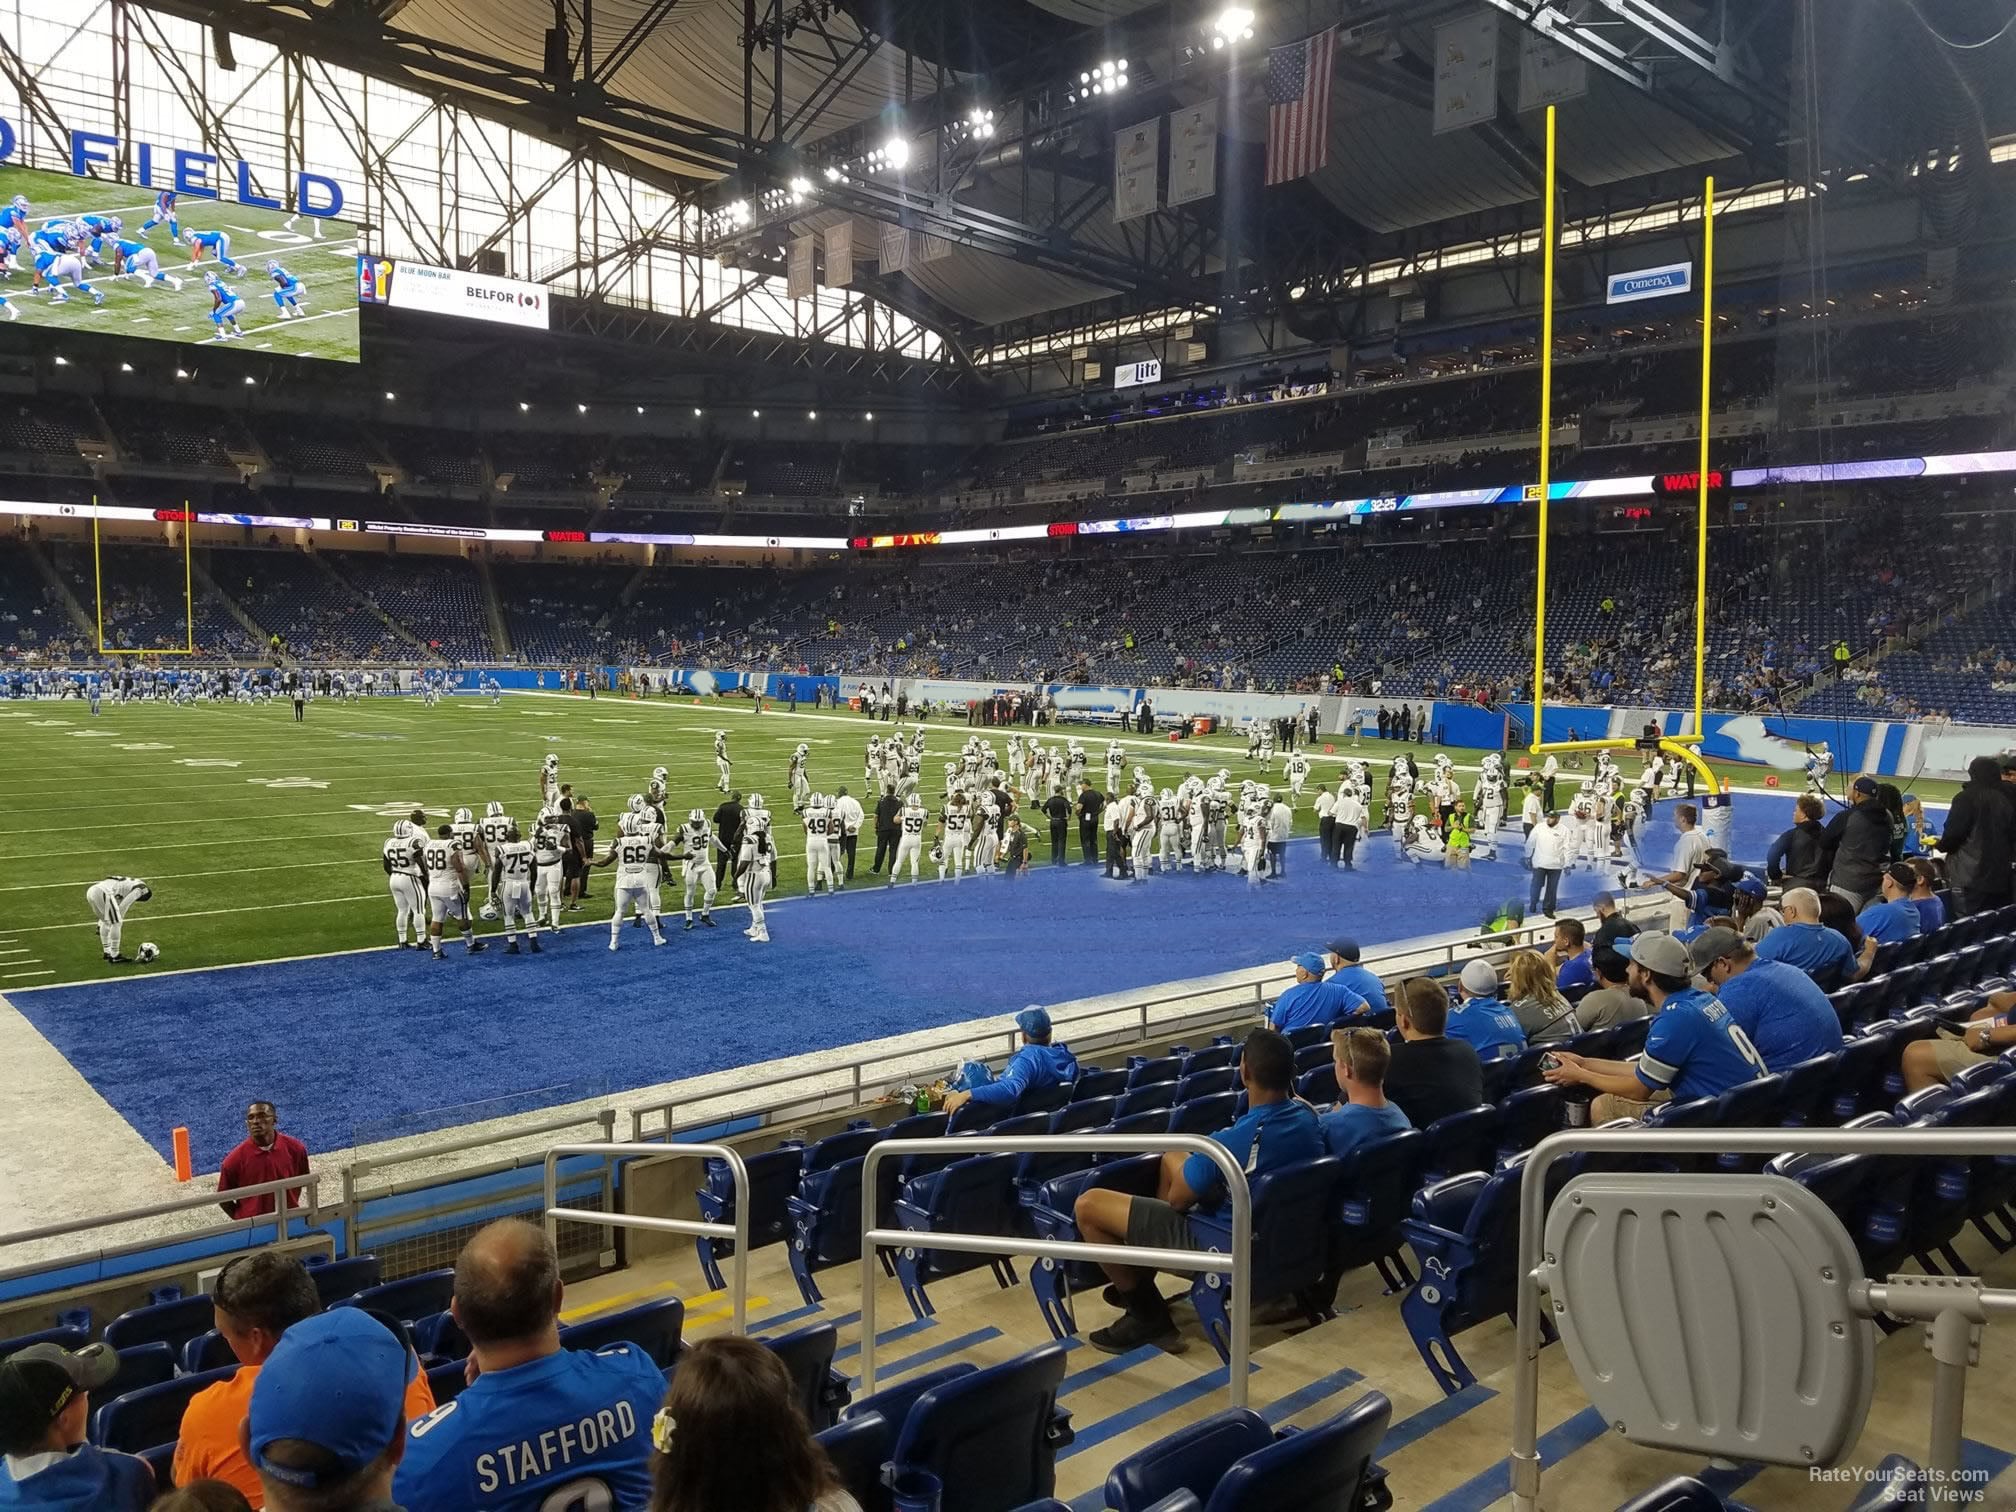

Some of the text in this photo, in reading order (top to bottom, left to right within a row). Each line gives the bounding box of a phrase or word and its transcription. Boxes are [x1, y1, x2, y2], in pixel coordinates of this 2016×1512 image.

[71, 129, 344, 218] FIELD
[400, 266, 451, 280] BLUE MOON BAR
[466, 286, 515, 303] BELFOR
[1135, 363, 1158, 382] Lite
[1370, 497, 1397, 512] 32:25
[548, 531, 586, 542] WATER
[1050, 522, 1077, 536] STORM
[1292, 761, 1304, 774] 18
[1161, 805, 1176, 821] 31
[807, 818, 826, 834] 49
[905, 817, 923, 833] 59
[947, 814, 966, 830] 53
[485, 824, 508, 843] 93
[692, 833, 710, 850] 96
[387, 847, 410, 868] 65
[426, 848, 447, 871] 98
[506, 851, 531, 875] 75
[623, 845, 646, 864] 66
[1728, 1024, 1769, 1080] 9
[476, 1400, 636, 1493] STAFFORD
